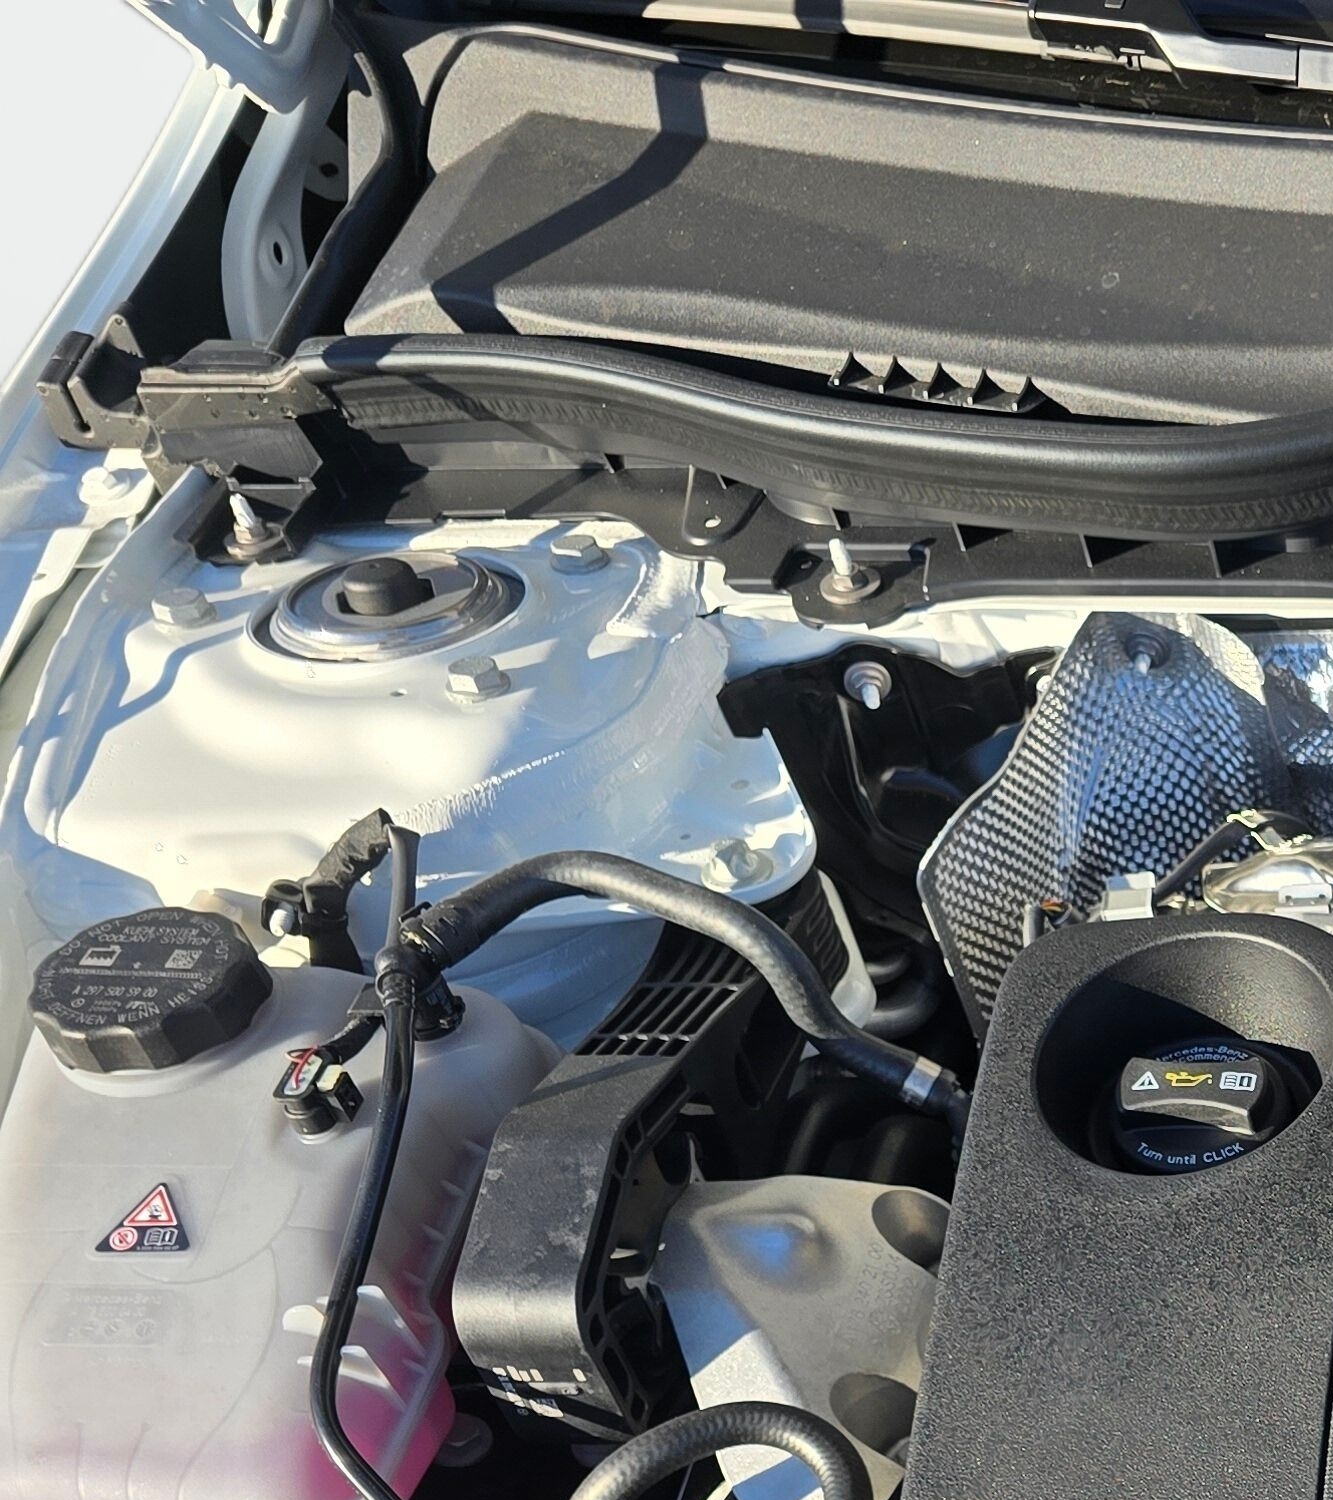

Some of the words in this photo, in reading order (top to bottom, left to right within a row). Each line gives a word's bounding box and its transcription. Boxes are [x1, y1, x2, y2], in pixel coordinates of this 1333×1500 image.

[59, 940, 81, 957] DO
[88, 921, 121, 938] NOT
[136, 911, 184, 923] OPEN
[72, 986, 81, 995] A
[117, 1006, 161, 1025] WENN
[1156, 1045, 1249, 1062] ercedes-Benz
[1136, 1142, 1163, 1161] Turn
[1167, 1154, 1197, 1165] until
[1203, 1142, 1245, 1163] CLICK
